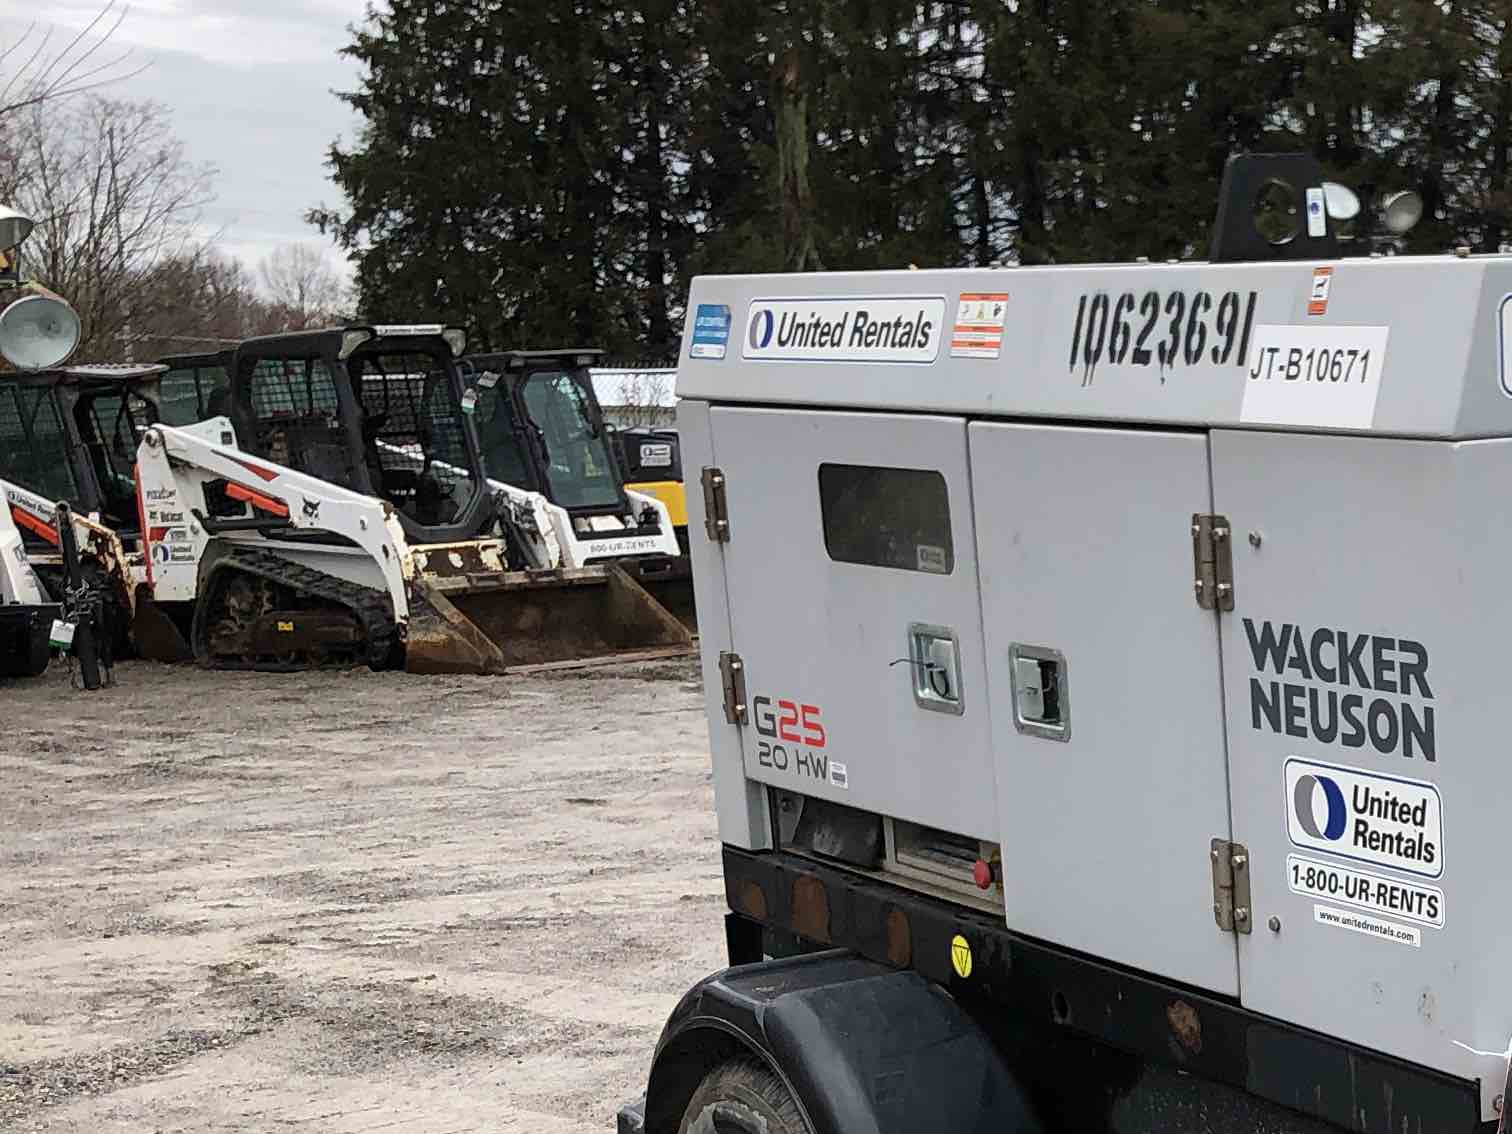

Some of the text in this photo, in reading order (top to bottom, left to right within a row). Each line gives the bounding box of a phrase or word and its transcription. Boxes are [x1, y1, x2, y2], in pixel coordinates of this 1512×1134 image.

[777, 311, 845, 348] United
[849, 310, 932, 349] Rentals
[1250, 346, 1371, 383] JT-B10671
[1242, 618, 1435, 699] WACKER
[753, 696, 826, 748] G25
[1249, 677, 1436, 762] NEUSON
[758, 741, 788, 770] 20
[1352, 784, 1428, 828] United
[1352, 818, 1436, 864] Rentals
[1292, 864, 1439, 919] 1-800-UR-RENTS
[1319, 910, 1414, 942] www.unitedrentals.com
